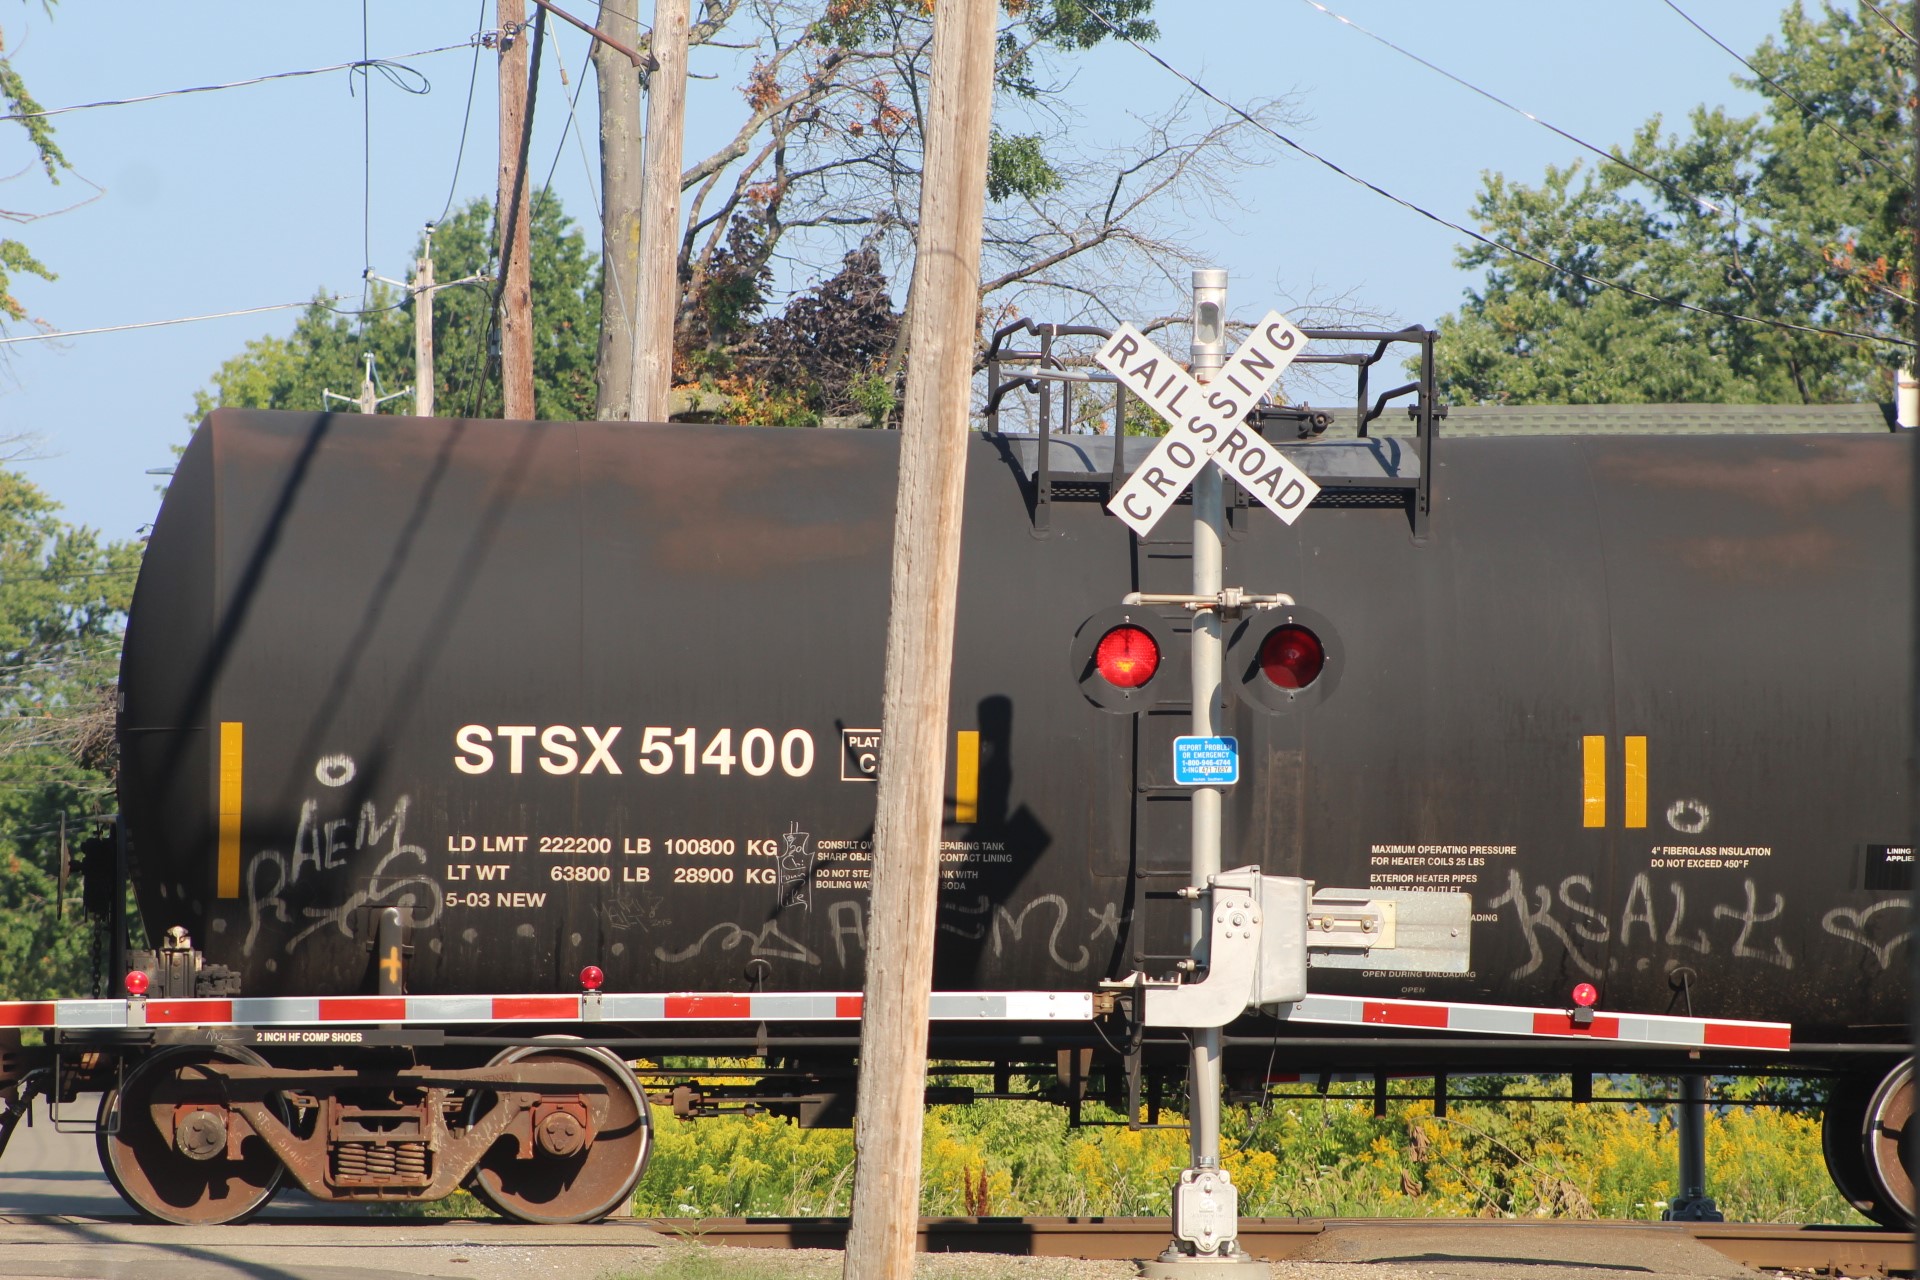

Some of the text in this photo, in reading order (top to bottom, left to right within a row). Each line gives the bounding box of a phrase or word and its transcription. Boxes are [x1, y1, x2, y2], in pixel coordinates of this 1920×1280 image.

[1123, 322, 1295, 521] CROSSING
[849, 736, 880, 747] PLAT
[454, 725, 815, 777] STSX 51400
[860, 753, 876, 773] C
[448, 836, 778, 856] LD LMT 222200 LB 100800 KG
[818, 841, 858, 849] CONSULT
[940, 842, 1005, 851] EPAIRING TANK
[1371, 845, 1517, 855] MAXIMUM OPERATING PRESSURE
[1663, 846, 1717, 855] FIBERGLASS
[1719, 847, 1771, 856] INSULATION
[817, 853, 872, 861] SHARP OBJE
[940, 853, 1013, 862] CONTACT LINING
[1371, 857, 1485, 866] FOR HEATER COILS 25 LBS
[1651, 859, 1664, 868] DO
[1666, 859, 1685, 868] NOT
[1687, 859, 1722, 868] EXCEED
[447, 864, 777, 884] LT WT 63800 LB 28900 KG
[816, 869, 830, 878] DO
[831, 869, 850, 878] NOT
[941, 870, 979, 879] NK WITH
[1370, 874, 1477, 883] EXTERIOR HEATER PIPES
[816, 880, 851, 889] BOILING
[942, 882, 966, 890] SODA
[446, 892, 546, 908] 5-03 NEW
[256, 1032, 363, 1042] 2 INCH HF COMP SHOES
